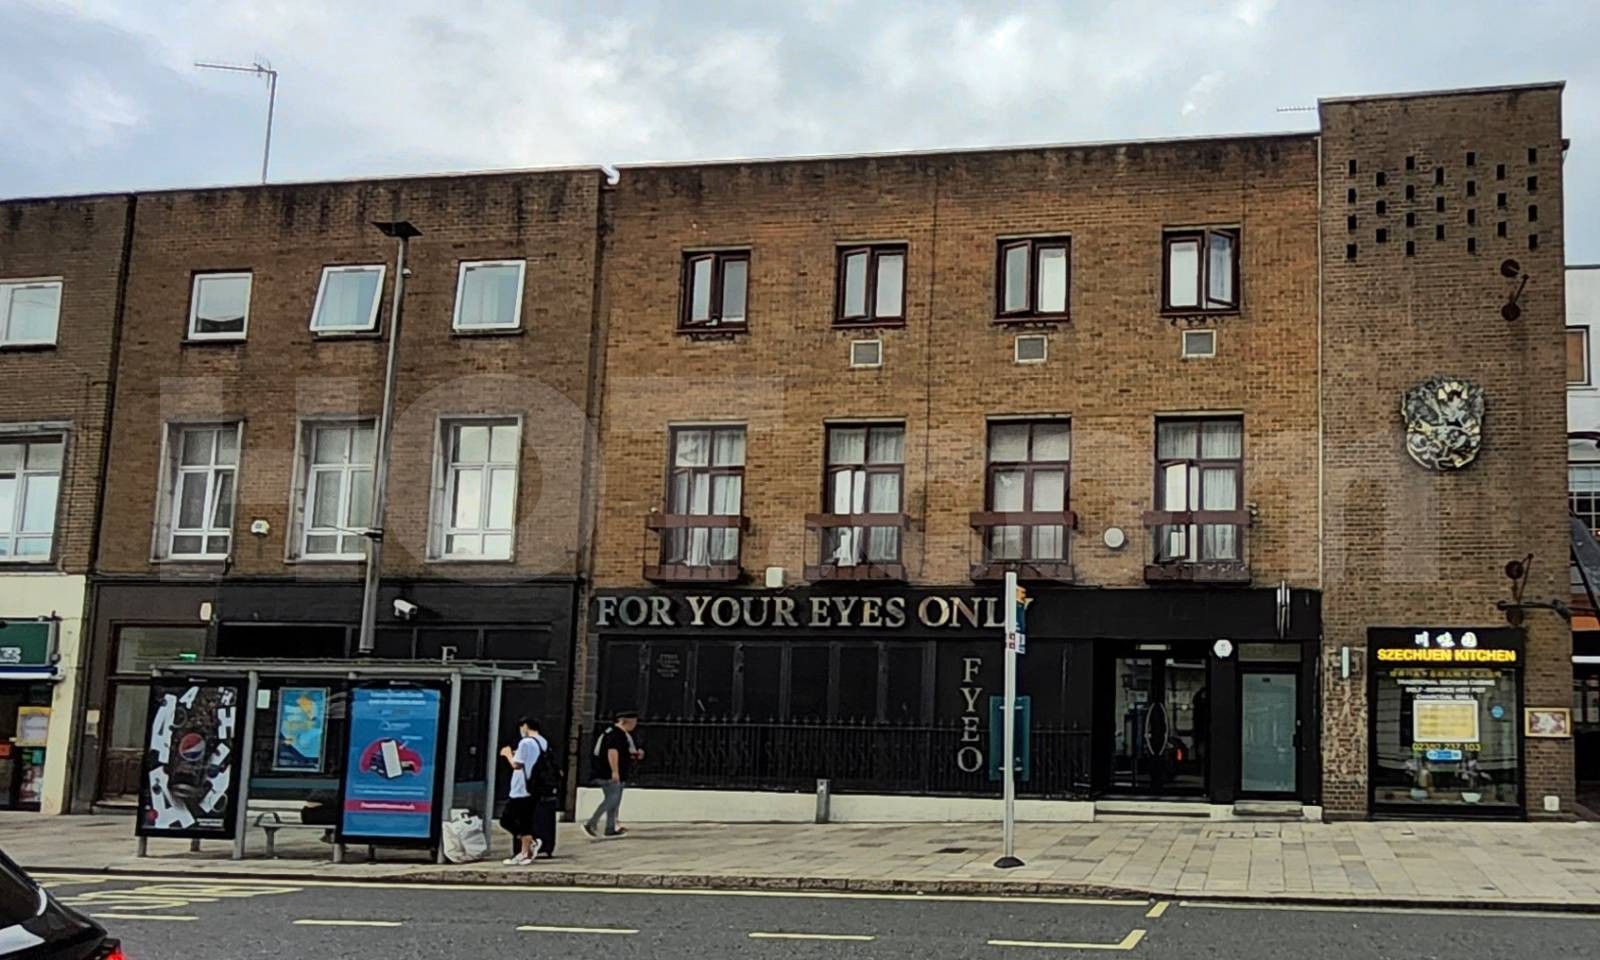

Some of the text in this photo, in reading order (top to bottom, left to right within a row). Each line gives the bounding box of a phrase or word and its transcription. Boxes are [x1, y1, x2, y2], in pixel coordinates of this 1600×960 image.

[595, 595, 1034, 628] FOR YOUR EYES ONL
[1377, 648, 1517, 662] SZECHUEN KITCHEN
[957, 657, 983, 772] FYEO
